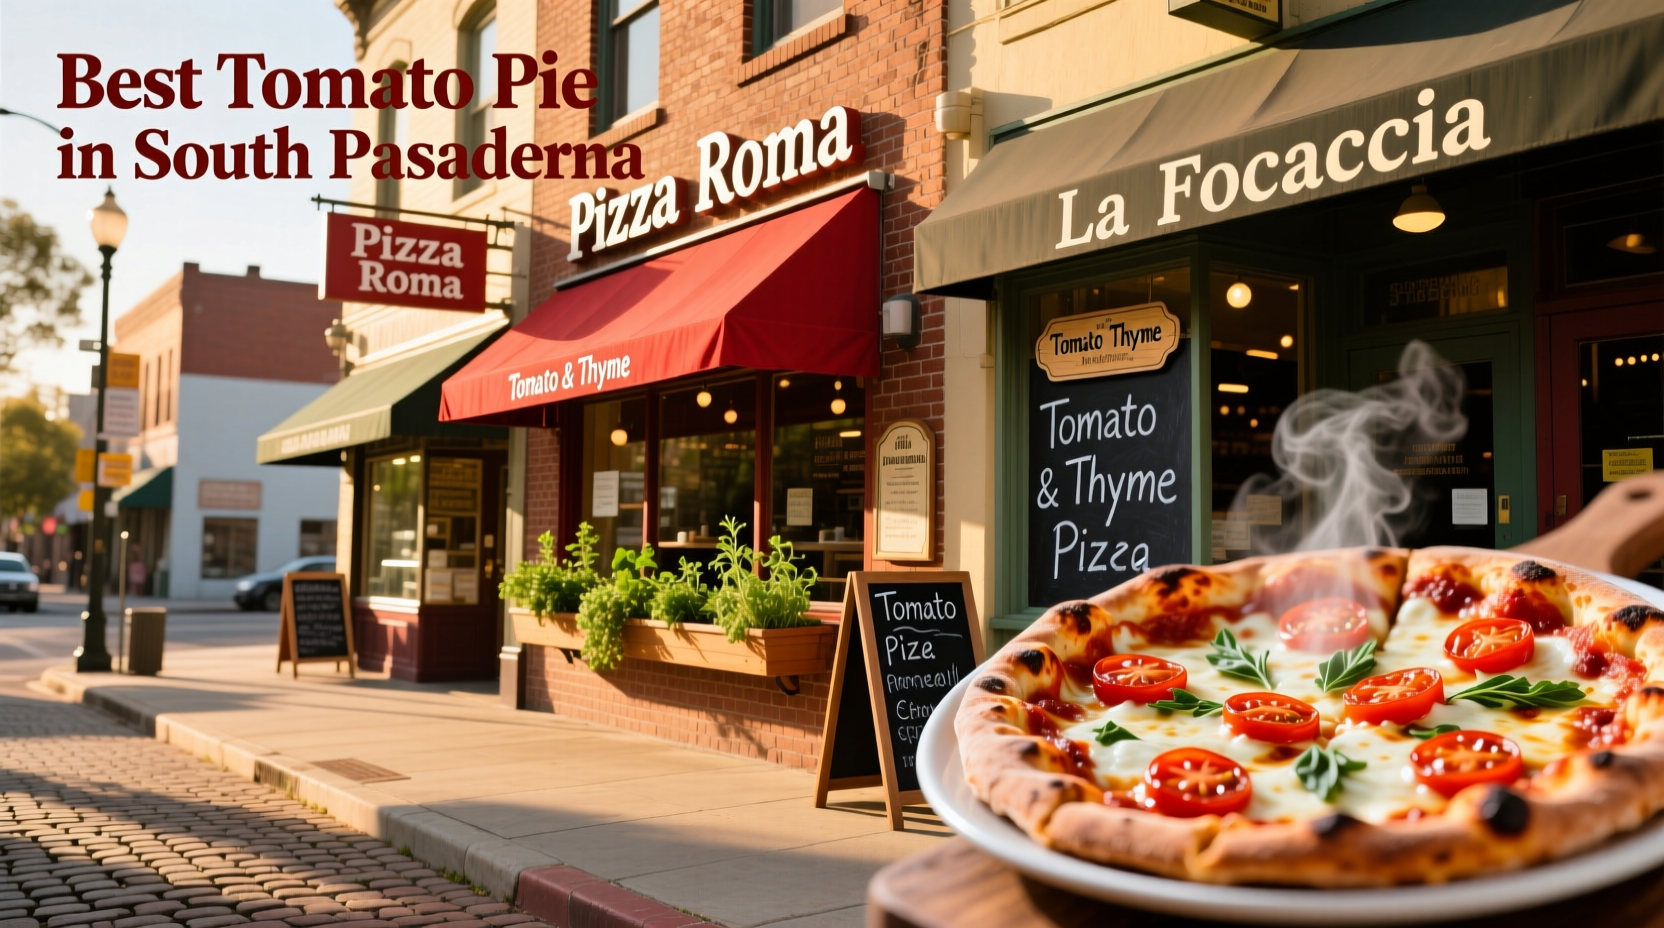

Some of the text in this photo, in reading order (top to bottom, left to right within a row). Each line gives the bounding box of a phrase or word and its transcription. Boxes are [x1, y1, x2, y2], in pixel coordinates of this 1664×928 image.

[567, 105, 854, 262] Pizza Roma
[1055, 87, 1492, 250] La Focaccia
[351, 222, 464, 269] Pizza
[358, 259, 464, 300] Roma
[1109, 321, 1162, 352] Thyme
[561, 361, 575, 390] &
[578, 354, 631, 391] Thyme
[1040, 393, 1157, 449] Tomato
[1037, 454, 1177, 527] & Thyme
[874, 591, 957, 621] Tomato
[885, 635, 936, 667] Pize
